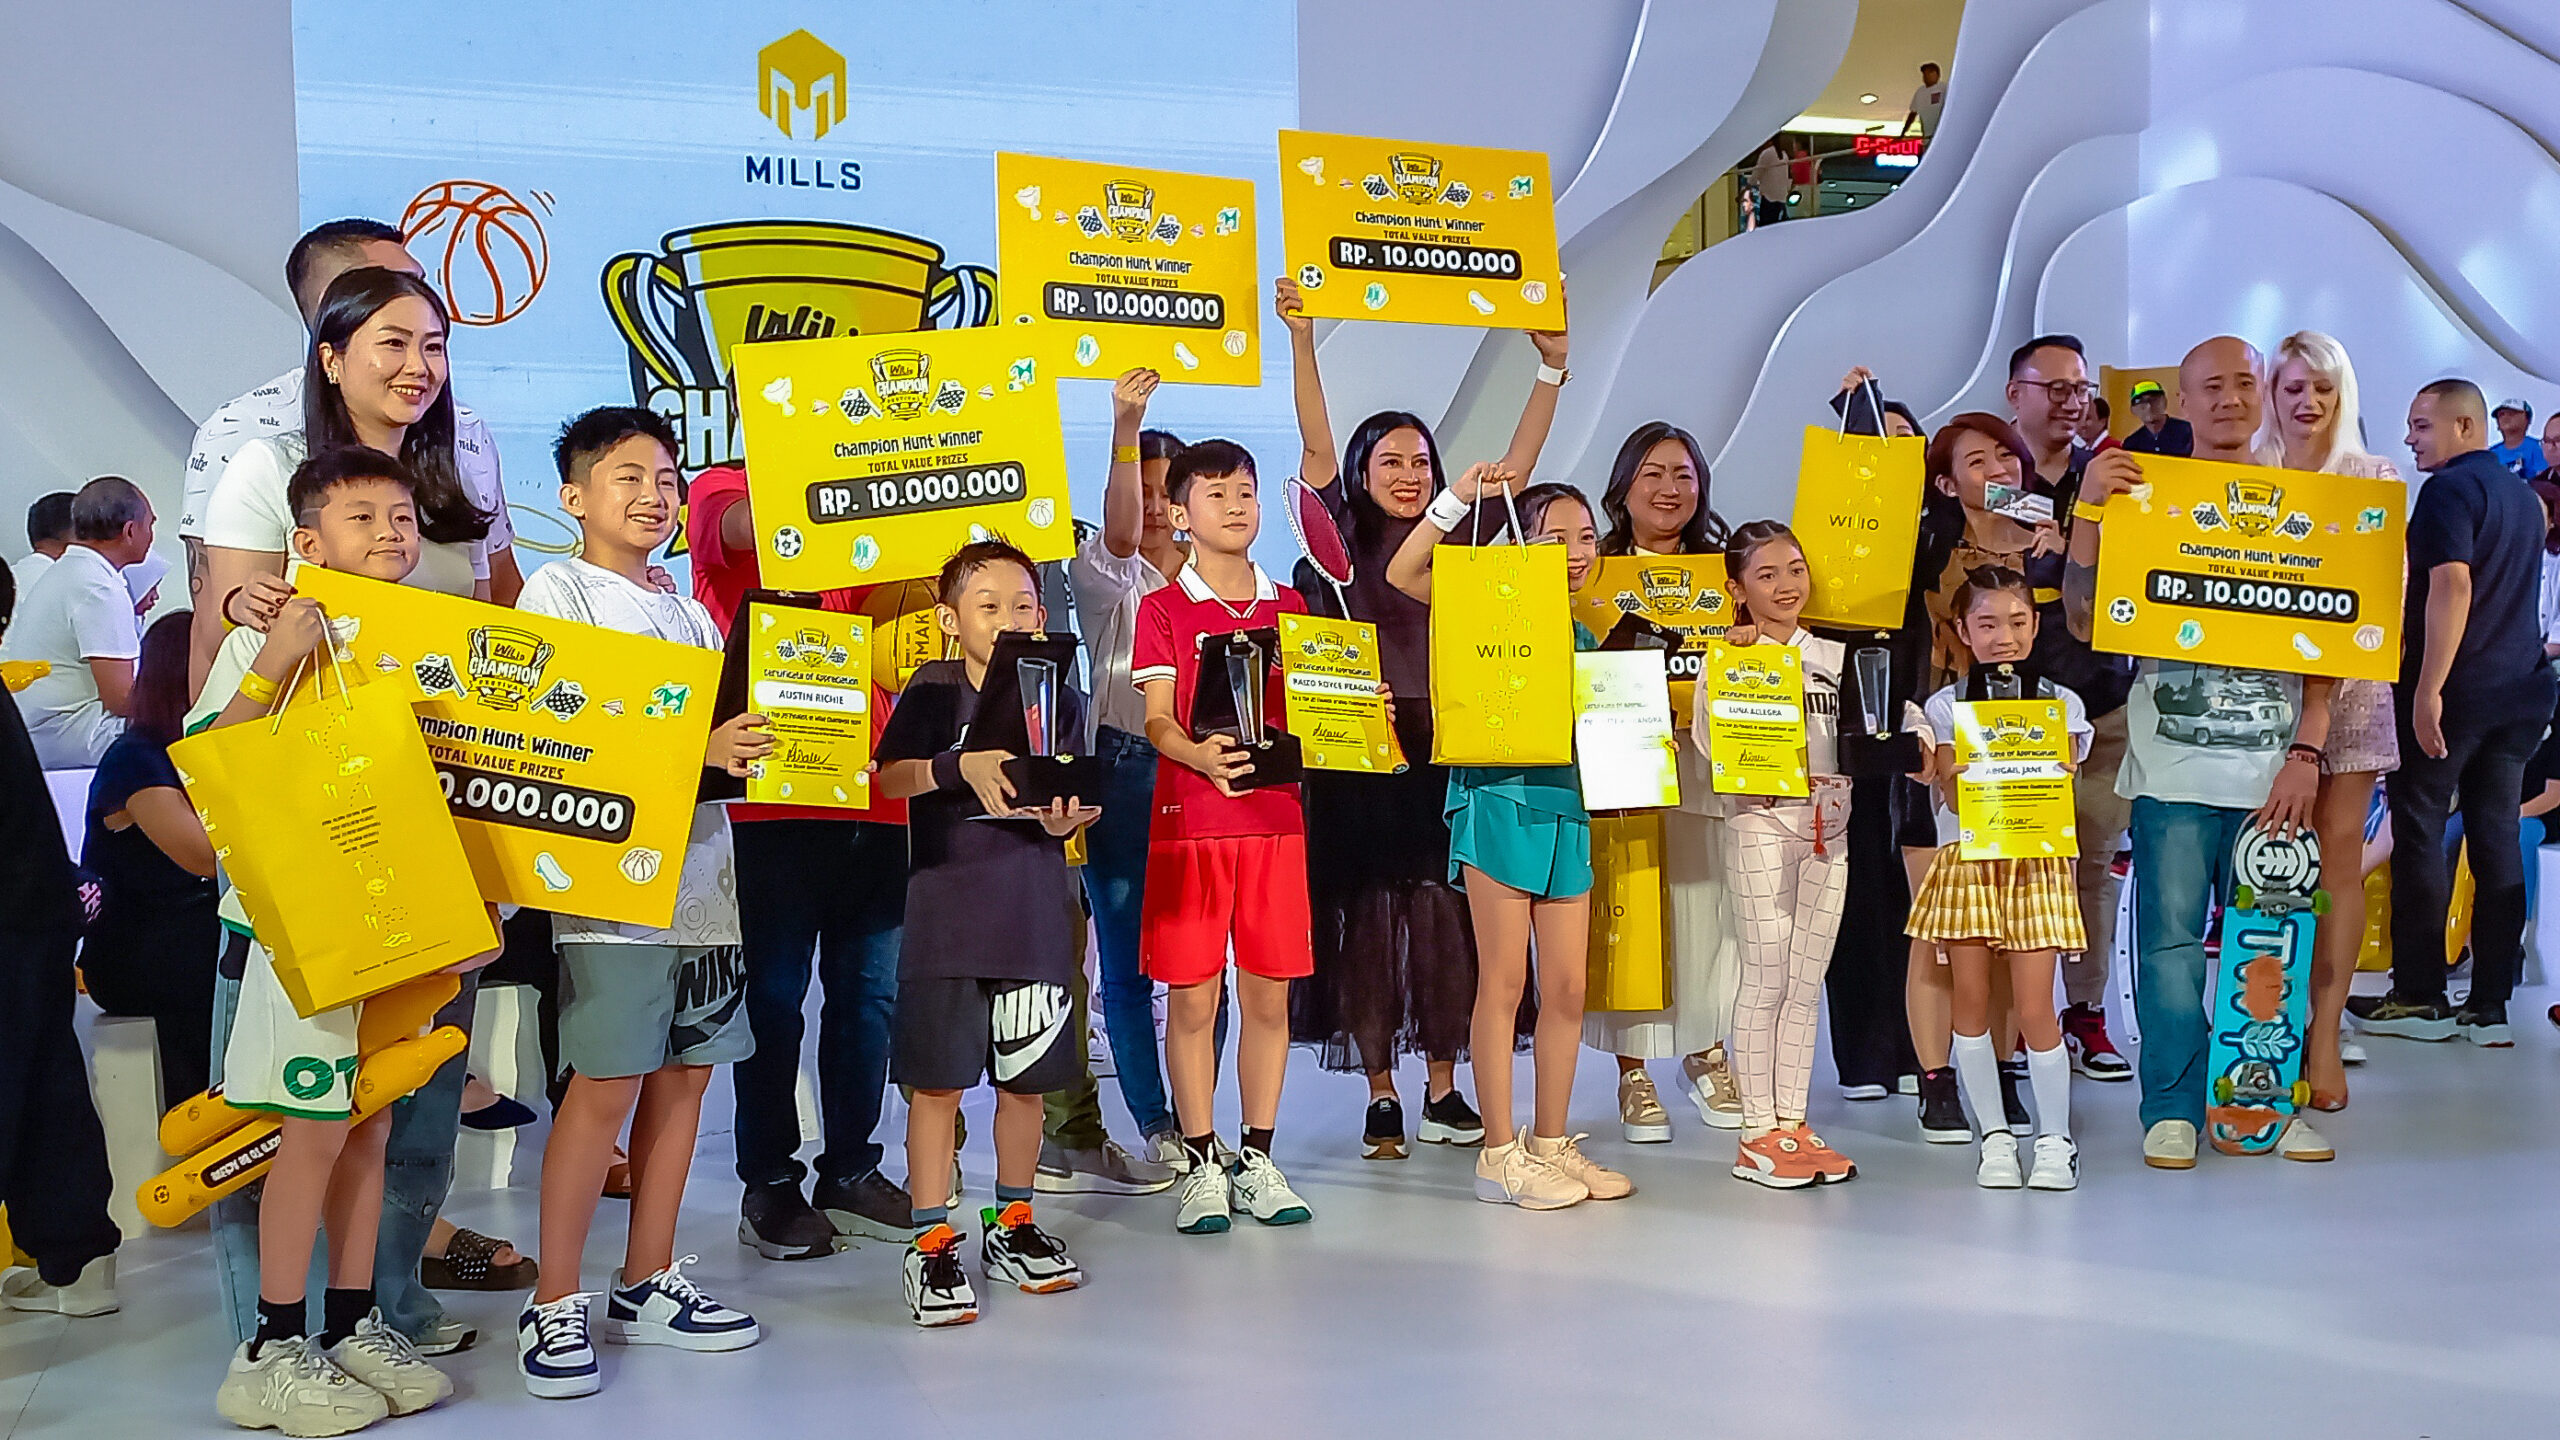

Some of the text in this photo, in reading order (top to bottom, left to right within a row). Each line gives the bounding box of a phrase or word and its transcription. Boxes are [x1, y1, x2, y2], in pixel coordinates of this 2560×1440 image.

[745, 156, 862, 191] MILLS
[1356, 211, 1485, 232] Champion Hunt Winner
[1383, 230, 1410, 241] TOTAL
[1412, 232, 1439, 243] VALUE
[1069, 251, 1193, 274] Champion Hunt Winner
[1382, 245, 1516, 273] 10.000.000
[1096, 273, 1122, 285] TOTAL
[1124, 275, 1150, 287] VALUE
[1093, 290, 1219, 322] 10.000.000
[876, 377, 929, 397] CHAMPION
[834, 430, 983, 458] Champion Hunt Winner
[868, 453, 968, 474] TOTAL VALUE PRIZES
[867, 467, 1020, 510] 10.000.000
[2179, 543, 2323, 569] Champion Hunt Winner
[2208, 564, 2236, 576] TOTAL
[2240, 567, 2270, 579] VALUE
[2203, 580, 2352, 617] 10.000.000
[469, 656, 541, 689] CHAMPION
[779, 690, 813, 702] AUSTIN
[482, 727, 525, 750] Hunt
[532, 737, 594, 762] Winner
[428, 744, 565, 780] TOTAL VALUE PRIZES
